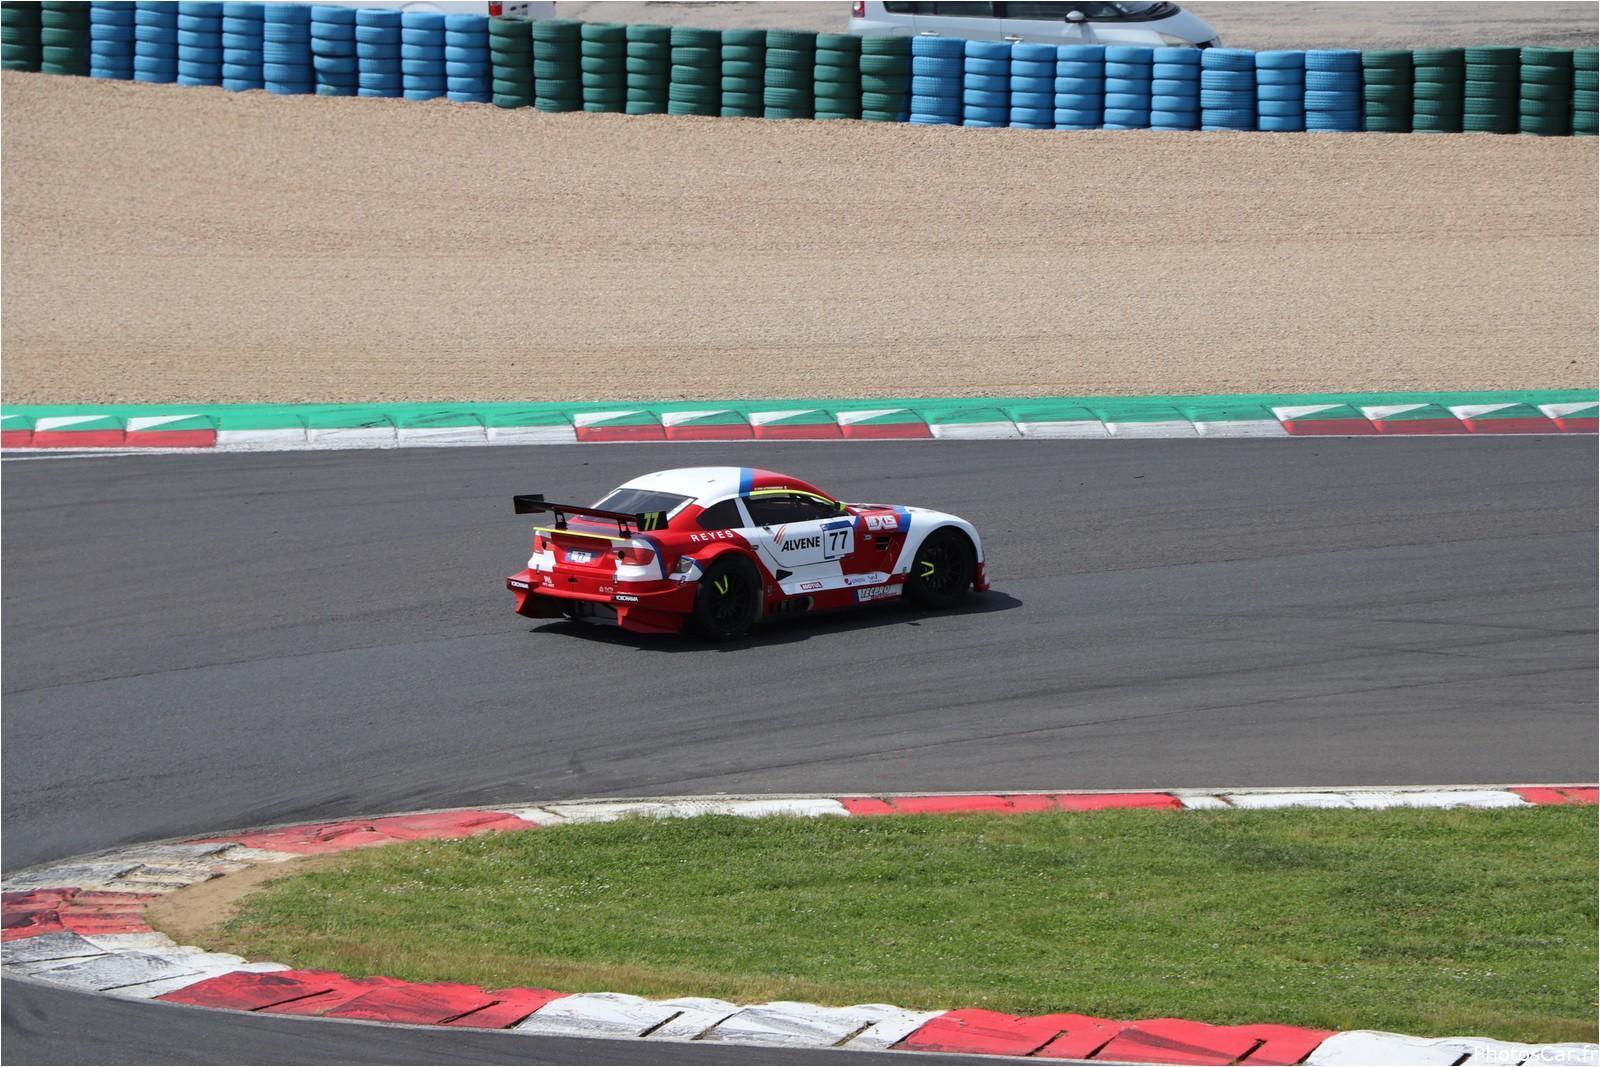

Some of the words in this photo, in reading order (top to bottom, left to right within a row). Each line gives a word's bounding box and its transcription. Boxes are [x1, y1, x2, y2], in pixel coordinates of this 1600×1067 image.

[644, 512, 660, 531] 77
[690, 530, 734, 542] REYES
[782, 536, 821, 552] ALVENE
[829, 531, 848, 551] 77
[576, 552, 586, 561] 77
